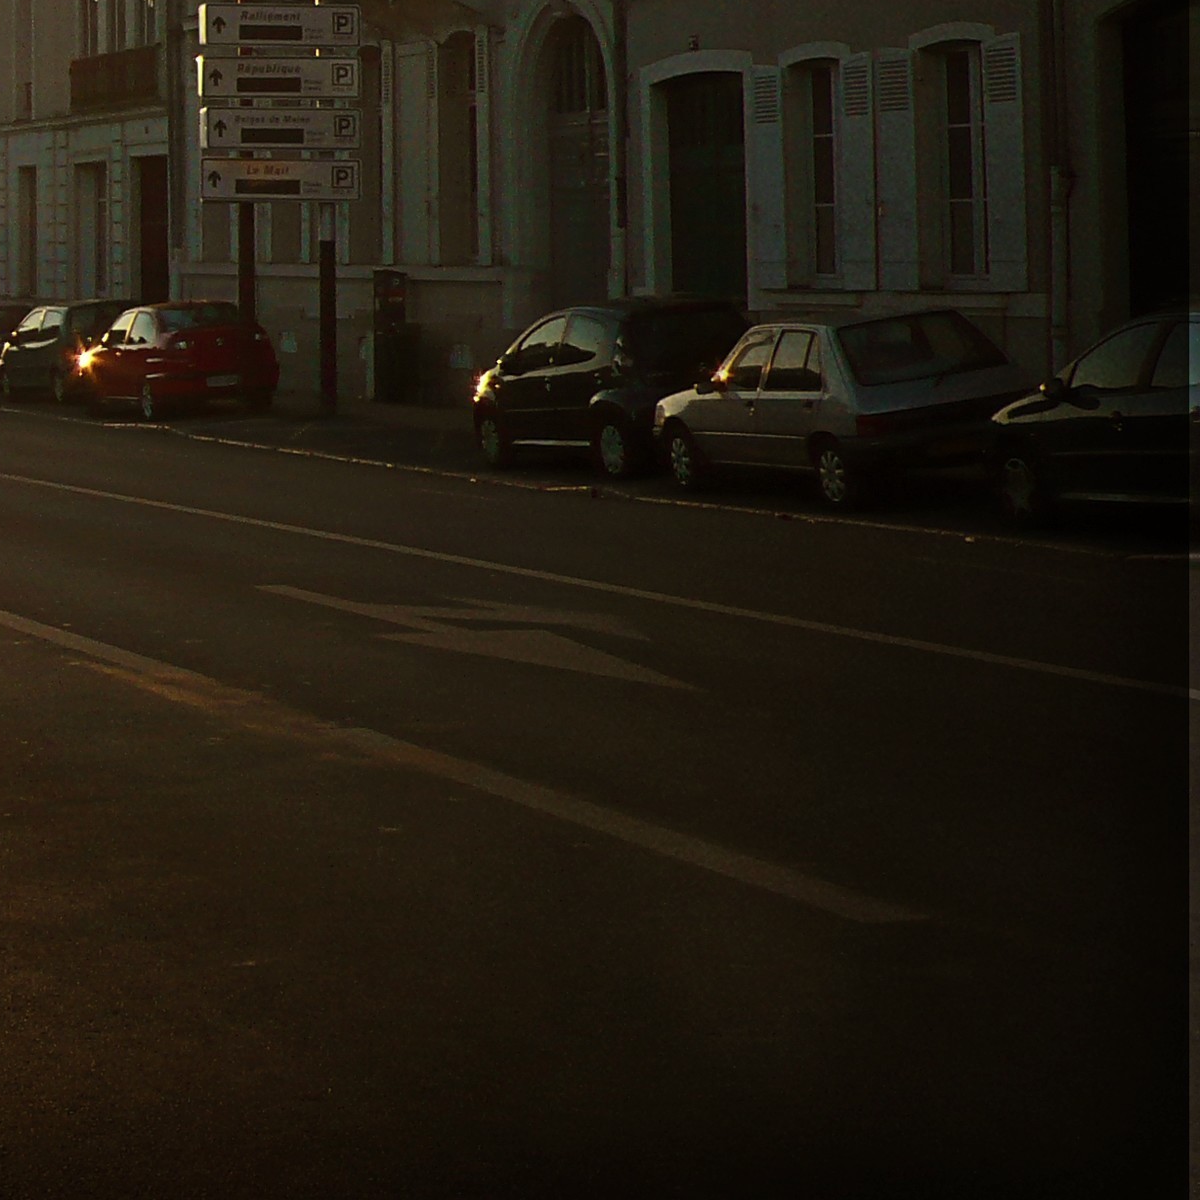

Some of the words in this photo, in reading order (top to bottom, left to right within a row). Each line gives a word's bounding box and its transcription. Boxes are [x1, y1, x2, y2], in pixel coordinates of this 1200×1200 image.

[240, 10, 301, 22] Ralliement
[336, 15, 349, 32] P
[237, 62, 301, 75] République
[335, 66, 349, 83] P
[337, 117, 351, 134] P
[264, 165, 289, 175] Mail
[336, 169, 349, 185] P
